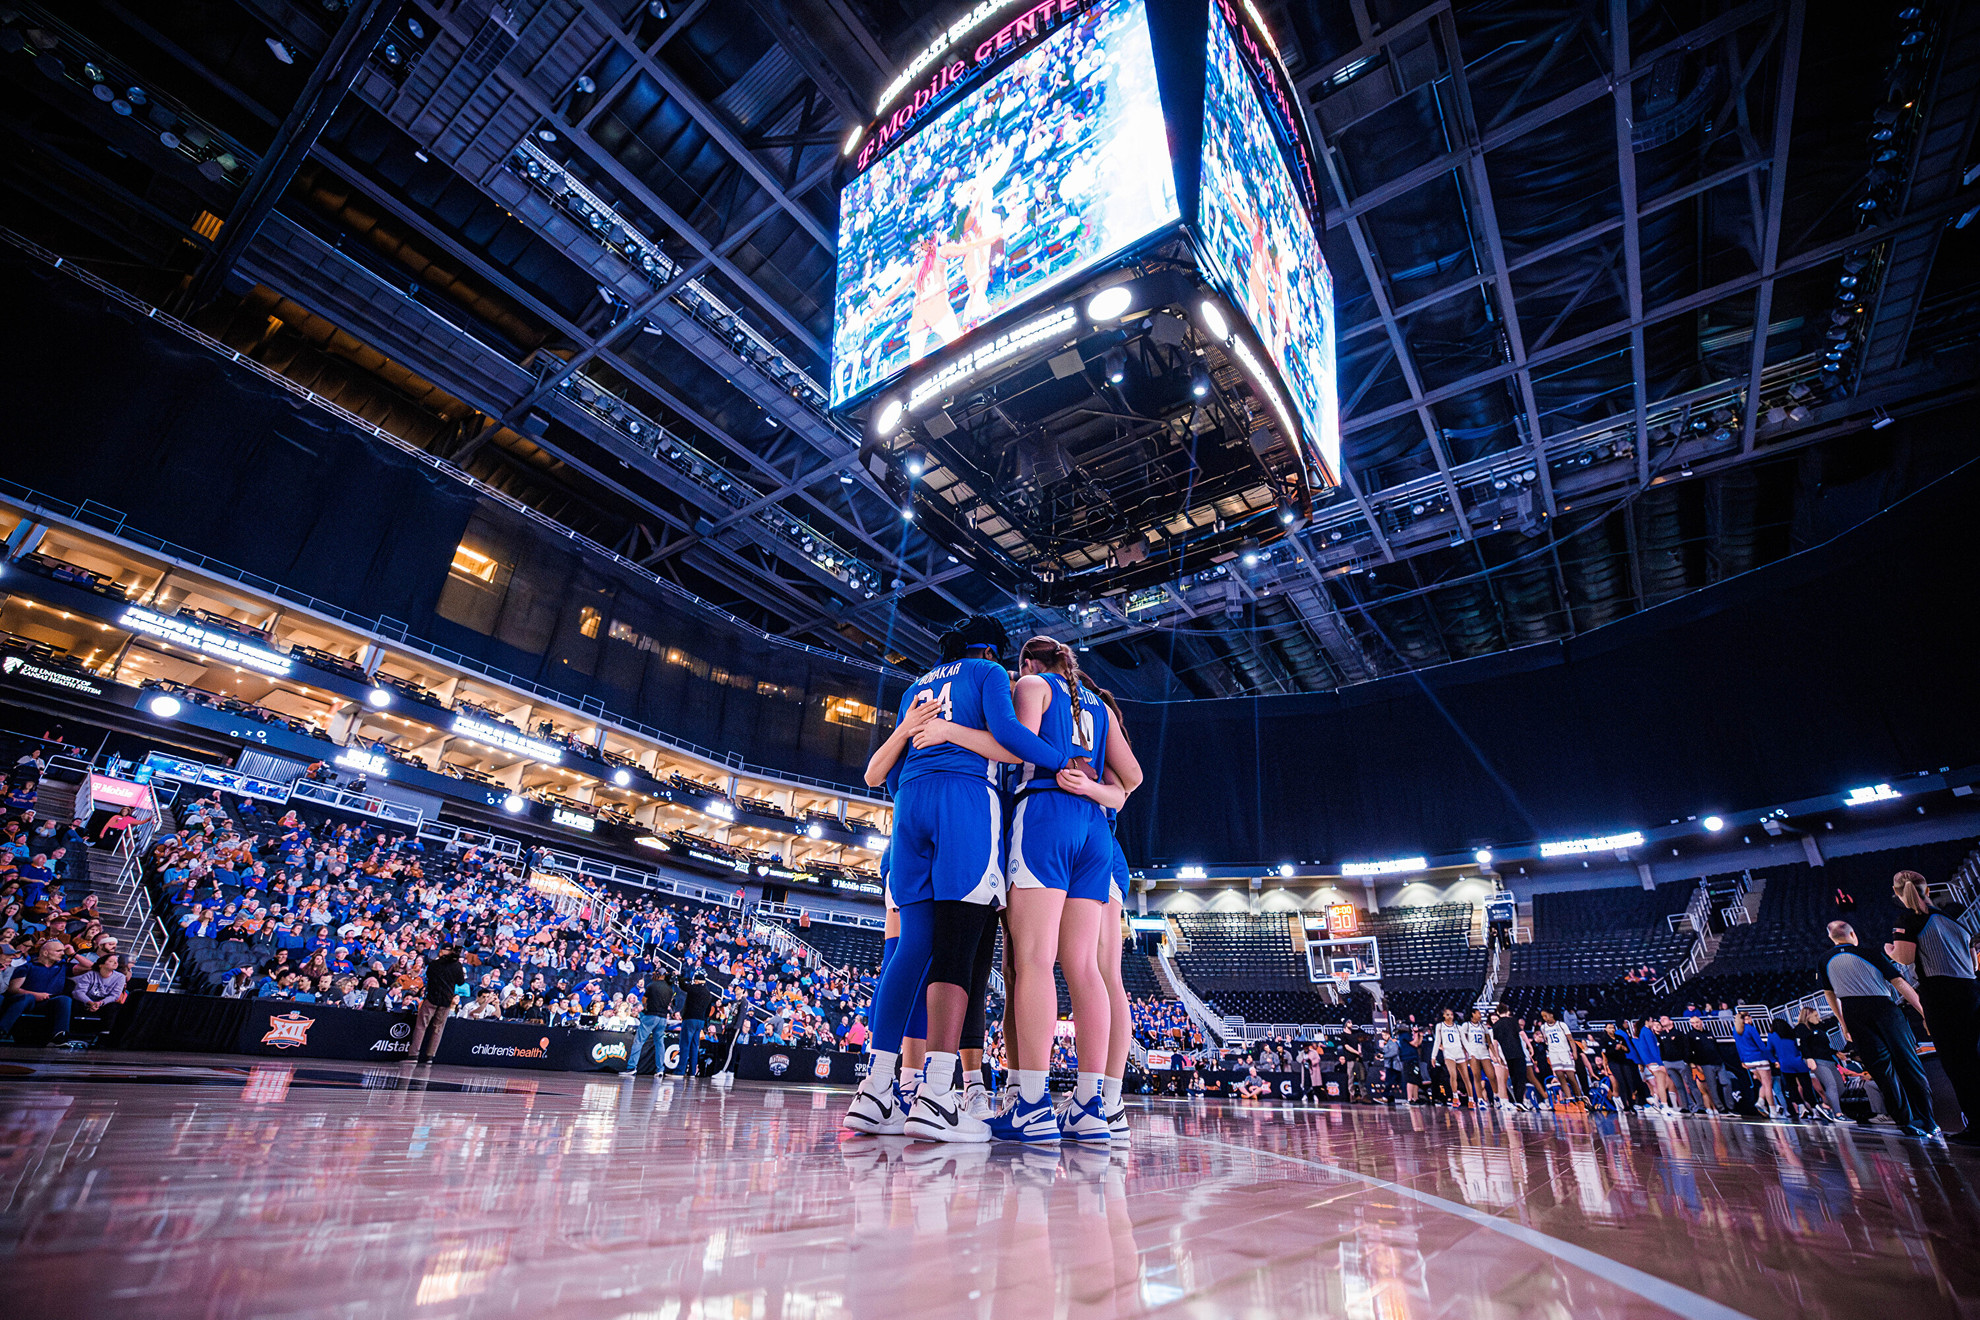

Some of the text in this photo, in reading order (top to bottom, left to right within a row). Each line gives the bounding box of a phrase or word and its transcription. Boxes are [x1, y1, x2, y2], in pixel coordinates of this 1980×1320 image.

[877, 60, 965, 151] Mobile
[974, 0, 1080, 63] CENTE
[20, 668, 102, 696] KANSAS HEALTH SYSTEM
[23, 663, 92, 687] THE UNIVERSITY OF
[1070, 705, 1094, 752] 10
[100, 783, 134, 798] Mobile
[838, 880, 860, 891] Mobile
[1447, 1033, 1455, 1043] 0
[1473, 1033, 1483, 1044] 12
[1549, 1032, 1560, 1044] 15
[369, 1039, 411, 1053] Allstat
[591, 1041, 627, 1064] Crush
[817, 1065, 828, 1074] 66
